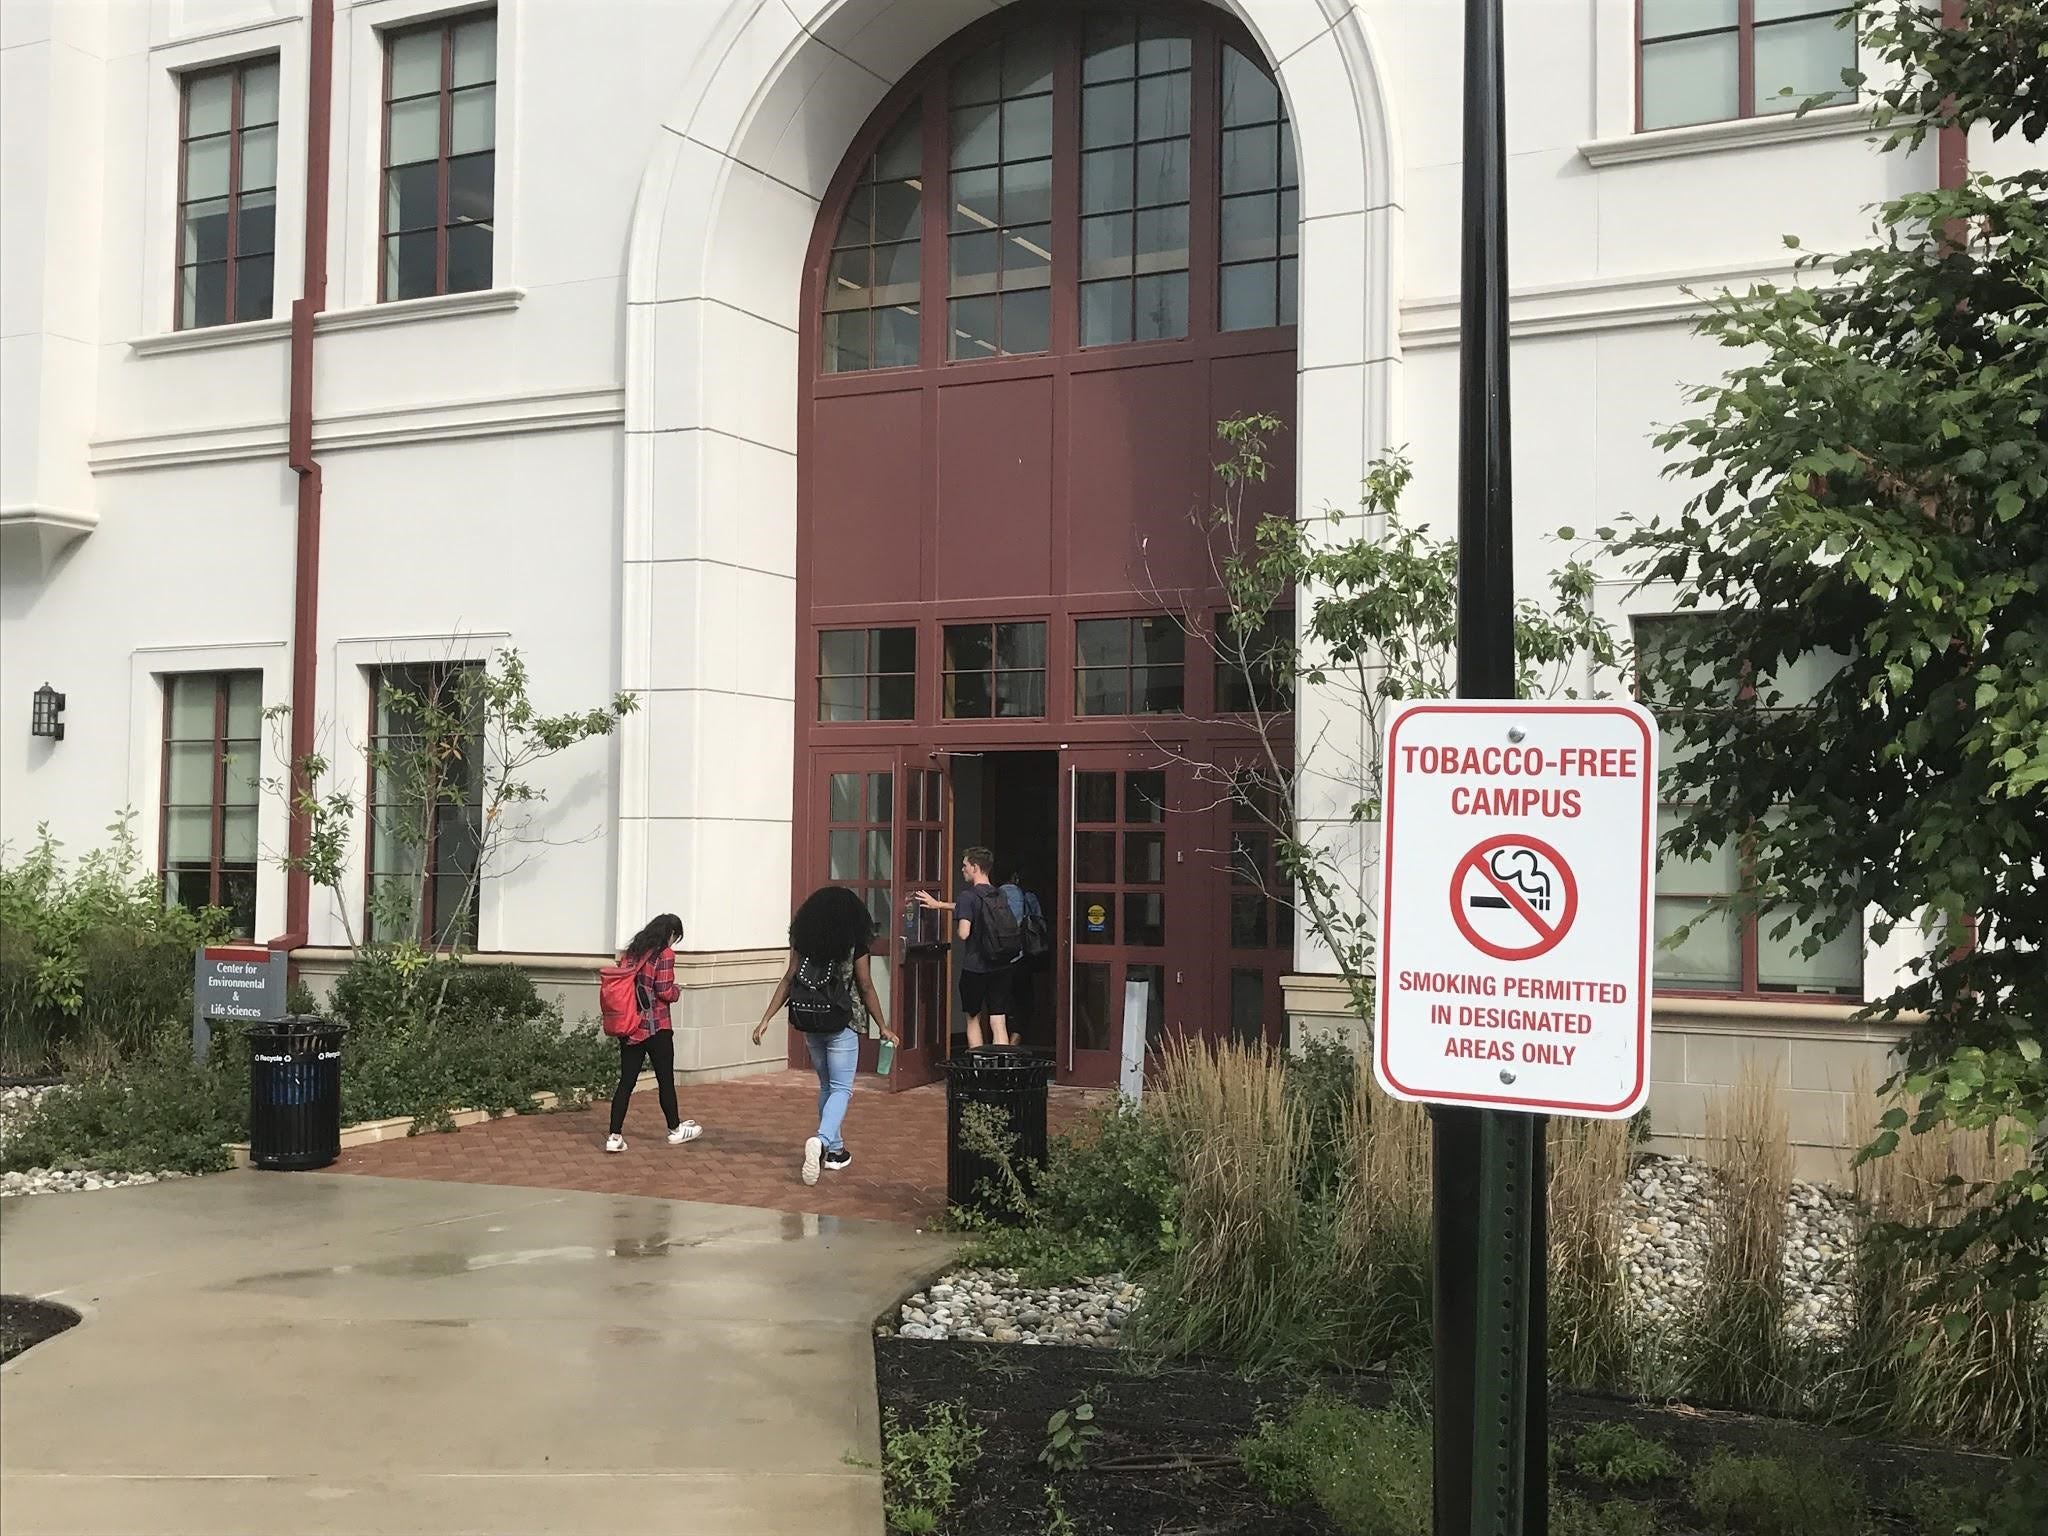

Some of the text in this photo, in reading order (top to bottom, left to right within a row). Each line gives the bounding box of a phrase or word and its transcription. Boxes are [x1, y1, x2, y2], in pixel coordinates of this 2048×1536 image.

[1402, 745, 1637, 778] TOBACCO-FREE
[1451, 787, 1582, 818] CAMPUS
[216, 962, 258, 975] Center for
[208, 975, 265, 989] Environmental
[1399, 971, 1627, 1004] SMOKING PERMITTED
[232, 990, 240, 1001] &
[211, 1003, 262, 1017] Life Sciences
[1430, 1004, 1592, 1034] IN DESIGNATED
[259, 1054, 283, 1063] Recycle
[1444, 1037, 1576, 1066] AREAS ONLY
